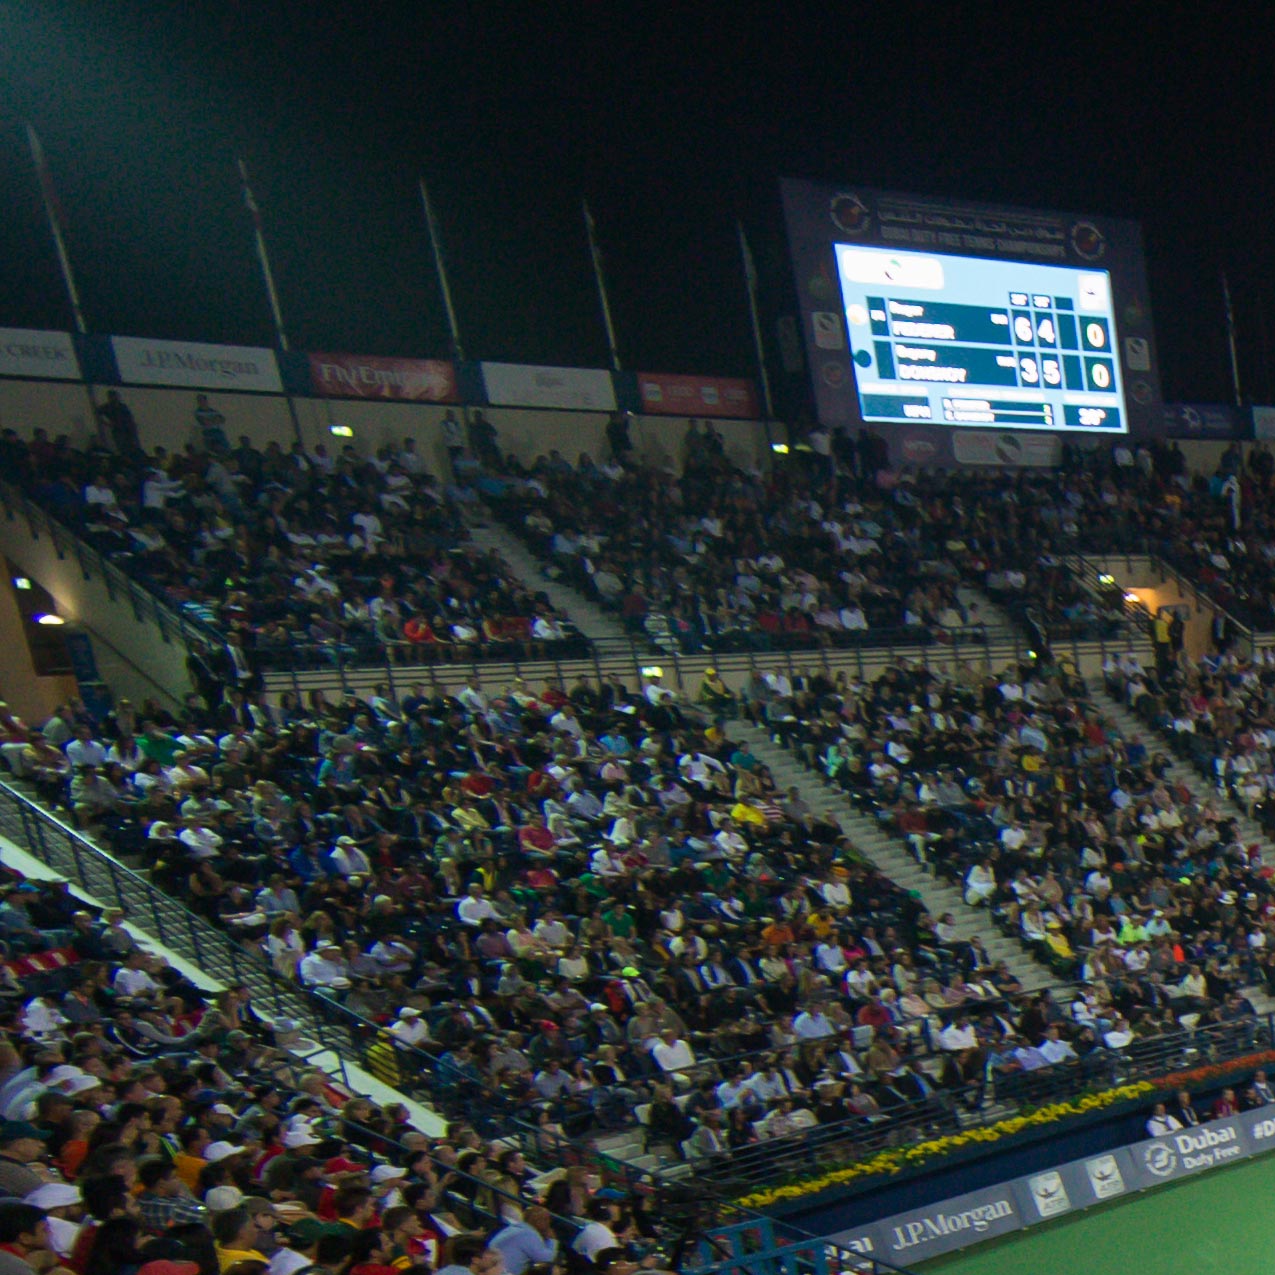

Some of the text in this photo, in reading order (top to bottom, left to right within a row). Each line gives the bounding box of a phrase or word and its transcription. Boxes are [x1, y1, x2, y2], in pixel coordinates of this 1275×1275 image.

[1015, 316, 1033, 341] 6
[1037, 319, 1055, 343] 4
[1087, 323, 1104, 347] 0
[1020, 358, 1038, 384] 3
[1043, 360, 1061, 384] 5
[1092, 363, 1110, 387] 0
[1175, 1126, 1237, 1154] Dubai
[1183, 1145, 1241, 1170] Duty Free
[892, 1199, 1013, 1250] J.P.Morgan
